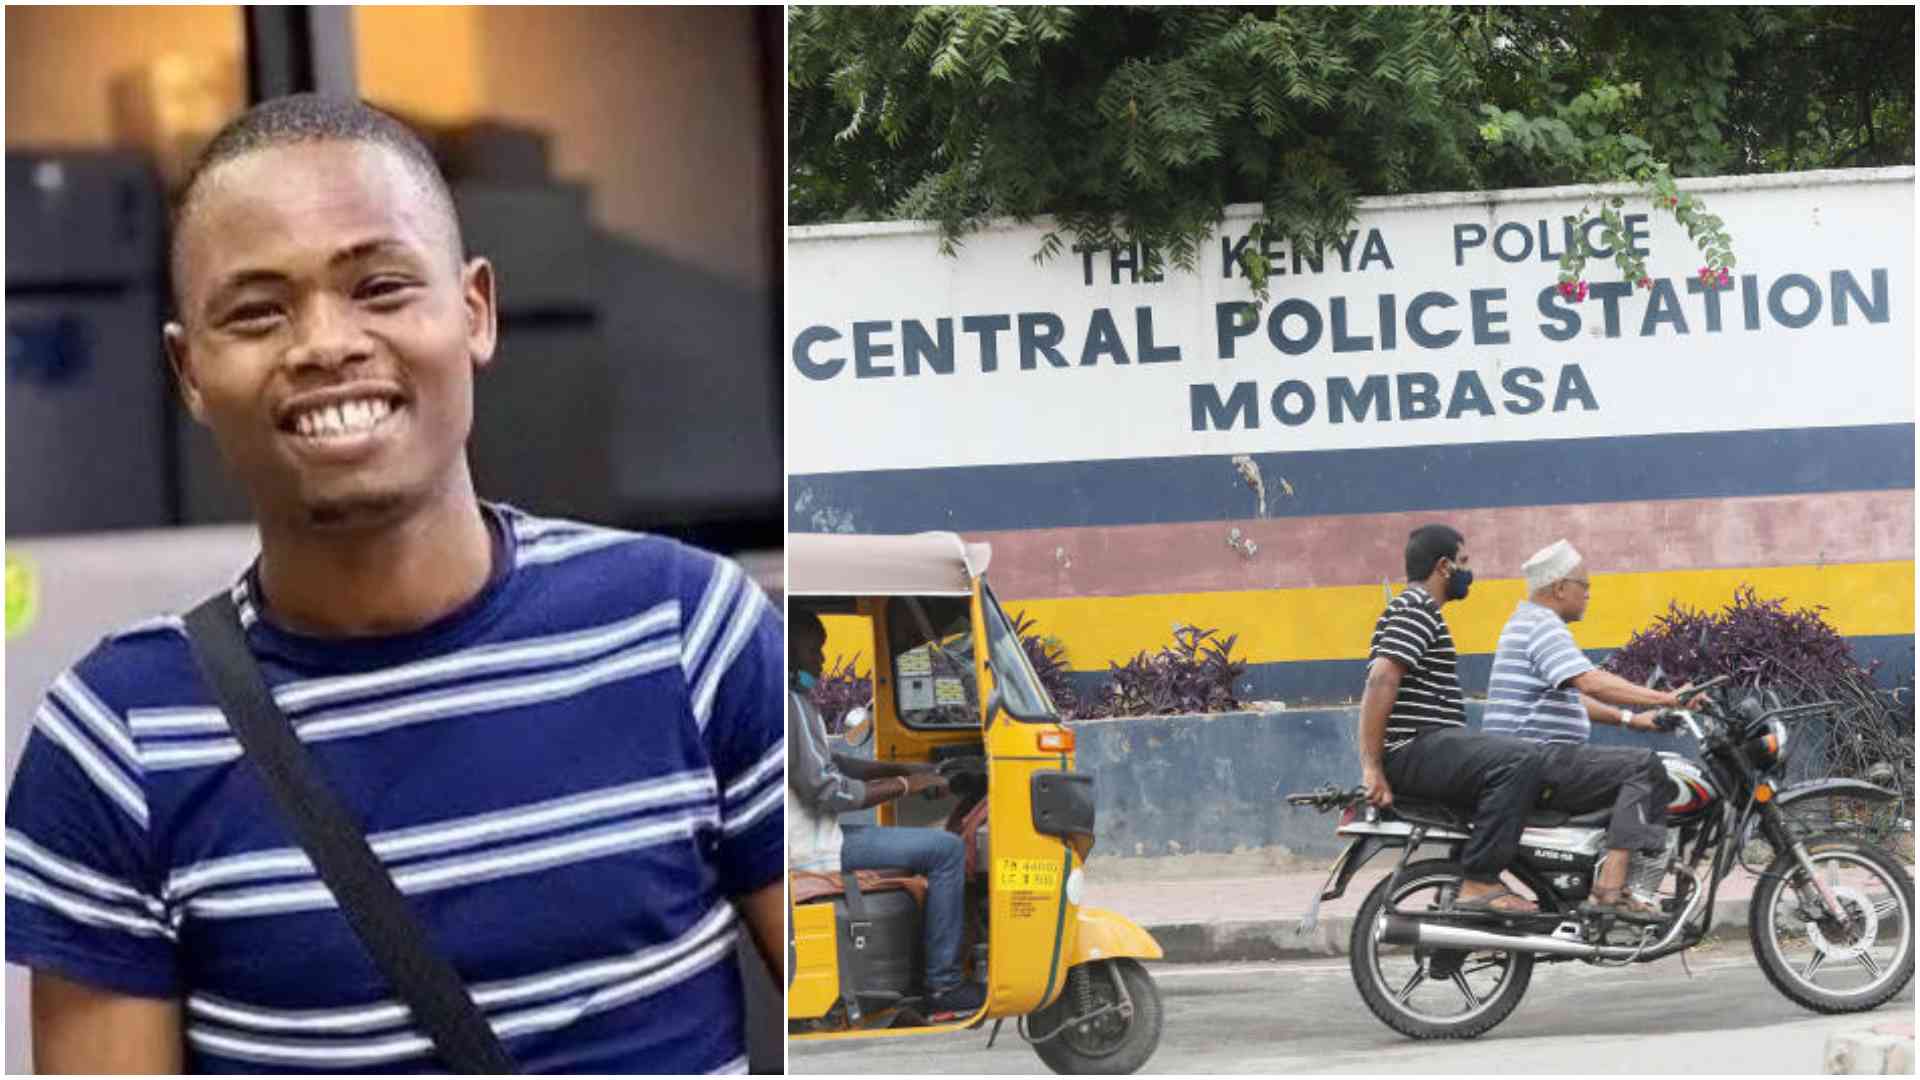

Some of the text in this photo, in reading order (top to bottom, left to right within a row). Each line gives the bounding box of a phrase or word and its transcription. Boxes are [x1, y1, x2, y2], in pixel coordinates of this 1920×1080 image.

[1221, 226, 1394, 279] KENYA
[1453, 213, 1650, 266] POLICE
[792, 267, 1891, 381] CENTRAL POLICE STATION
[1190, 363, 1599, 431] MOMBASA
